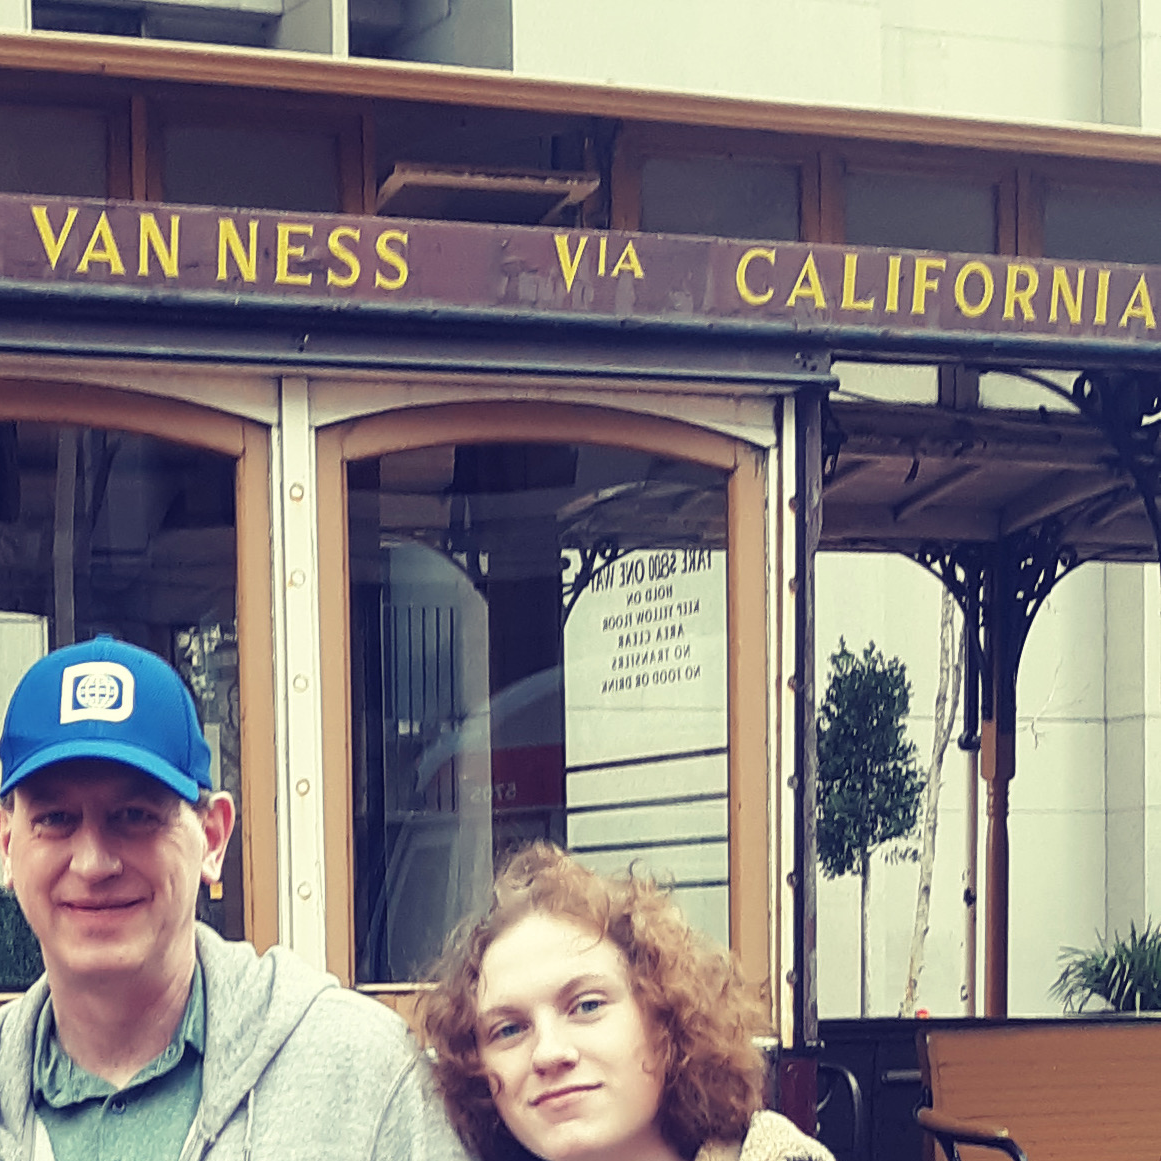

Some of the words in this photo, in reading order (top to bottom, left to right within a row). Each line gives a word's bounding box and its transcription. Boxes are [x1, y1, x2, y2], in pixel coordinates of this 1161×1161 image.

[31, 205, 180, 277] VAN
[216, 218, 409, 290] NESS
[553, 234, 644, 293] VIA
[735, 248, 1157, 329] CALIFORNIA
